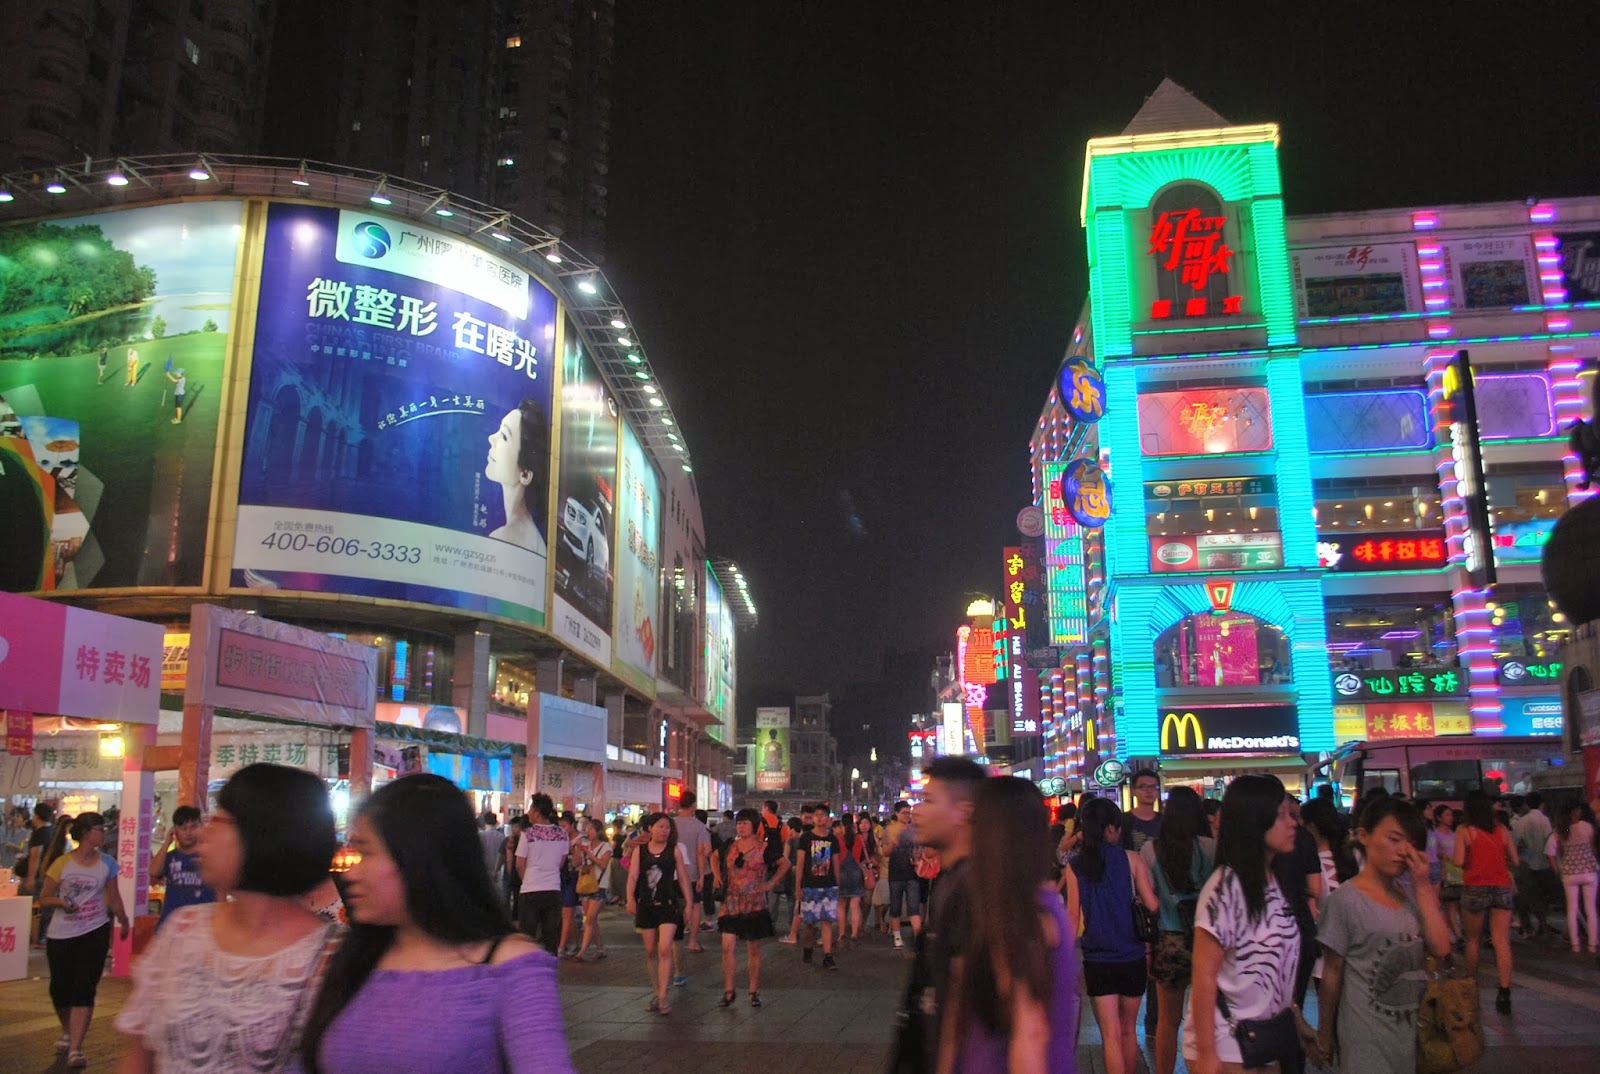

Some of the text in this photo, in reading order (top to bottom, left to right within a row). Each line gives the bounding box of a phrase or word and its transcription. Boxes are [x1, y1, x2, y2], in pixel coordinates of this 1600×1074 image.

[1190, 216, 1227, 232] KTV
[306, 277, 538, 380] 微整形 在曙光
[273, 520, 335, 534] 全国免费热线
[261, 532, 422, 564] 400-606-3333
[434, 544, 497, 563] www.gzsg.cn
[1206, 551, 1275, 567] 萨莉亚
[76, 645, 150, 689] 特卖场
[1528, 704, 1562, 713] watson
[1207, 735, 1299, 749] McDonald's
[42, 747, 99, 769] 特卖场
[216, 743, 307, 768] 季特卖场
[514, 773, 562, 789] 特场
[120, 816, 136, 879] 特卖场
